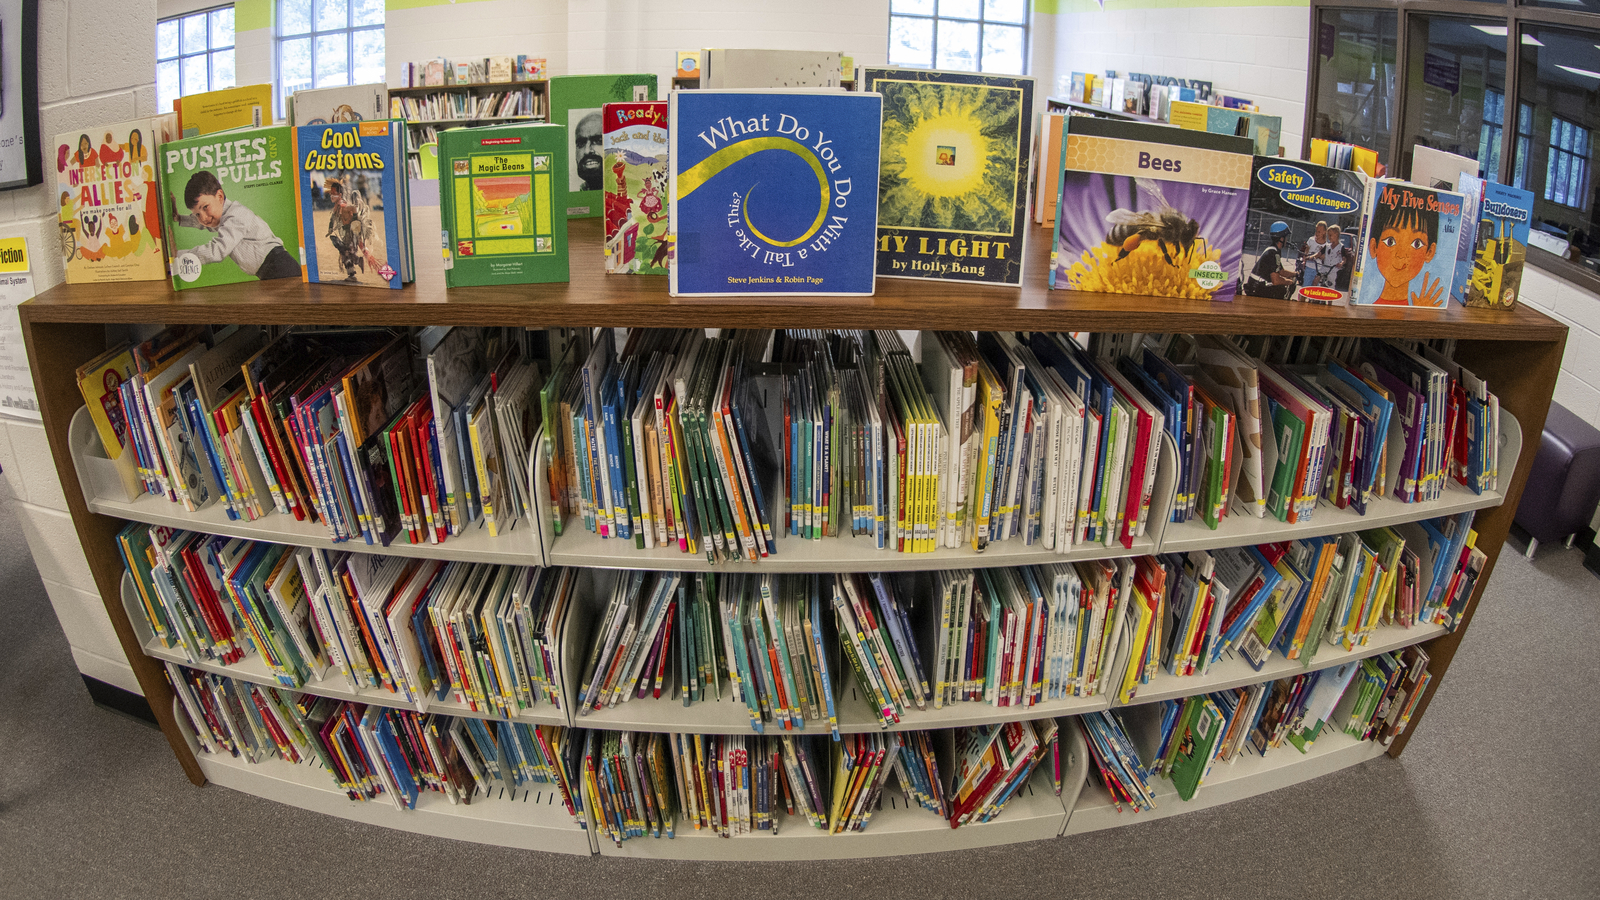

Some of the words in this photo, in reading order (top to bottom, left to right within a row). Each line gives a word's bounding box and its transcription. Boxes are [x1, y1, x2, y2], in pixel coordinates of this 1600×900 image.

[616, 104, 661, 125] Ready
[632, 130, 650, 140] and
[653, 132, 666, 144] the
[698, 113, 770, 150] What
[776, 113, 809, 140] Do
[0, 134, 24, 147] one's
[321, 126, 361, 149] Cool
[166, 137, 266, 174] PUSHES
[269, 135, 277, 158] AND
[304, 150, 384, 170] Customs
[812, 131, 842, 174] You
[1138, 151, 1182, 172] Bees
[69, 161, 140, 185] INTERSECTION
[217, 160, 282, 185] PULLS
[479, 164, 500, 172] Magic
[1268, 169, 1303, 188] Safety
[81, 179, 134, 206] ALLIES
[834, 177, 852, 208] Do
[1287, 192, 1315, 203] around
[1316, 195, 1351, 210] Strangers
[1380, 187, 1400, 210] My
[1401, 190, 1424, 209] Five
[1426, 195, 1460, 216] Senses
[727, 191, 742, 228] This?
[1485, 200, 1527, 219] Bulldozers
[810, 216, 848, 252] With
[1444, 224, 1454, 233] Aliki
[735, 229, 761, 259] Like
[797, 248, 808, 259] a
[876, 235, 908, 253] MY
[918, 237, 1010, 260] LIGHT
[0, 248, 24, 264] iction
[764, 250, 794, 267] Tail
[892, 259, 908, 272] by
[912, 260, 948, 274] Molly
[951, 262, 986, 277] Bang
[1194, 271, 1223, 279] INSECTS
[748, 276, 774, 284] Jenkins
[806, 276, 824, 285] Page
[985, 484, 991, 492] OF
[982, 493, 990, 517] ANIMALS
